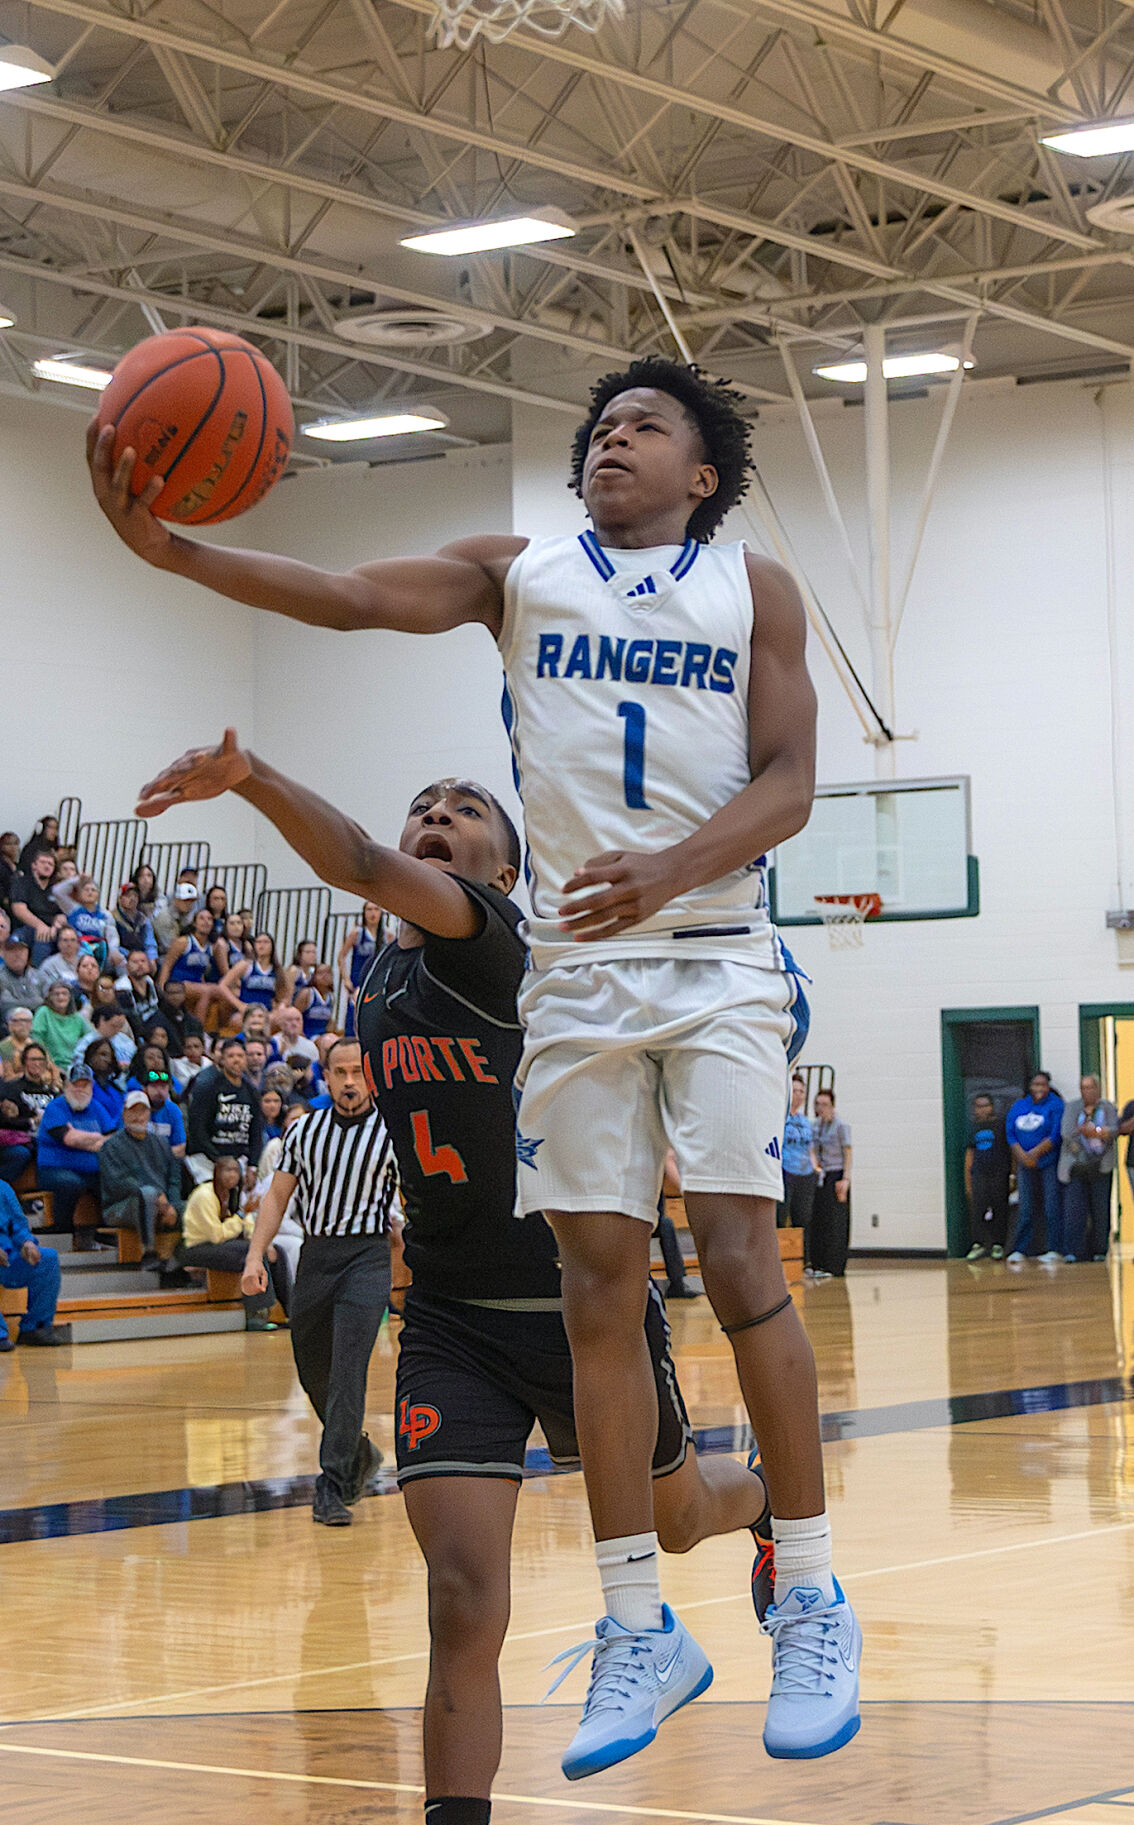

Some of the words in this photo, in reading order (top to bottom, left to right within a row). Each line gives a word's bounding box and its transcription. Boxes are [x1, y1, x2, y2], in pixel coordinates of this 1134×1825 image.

[537, 633, 738, 694] RANGERS
[616, 701, 653, 810] 1
[382, 1034, 499, 1090] PORTE
[410, 1109, 469, 1184] 4
[399, 1395, 442, 1453] LP
